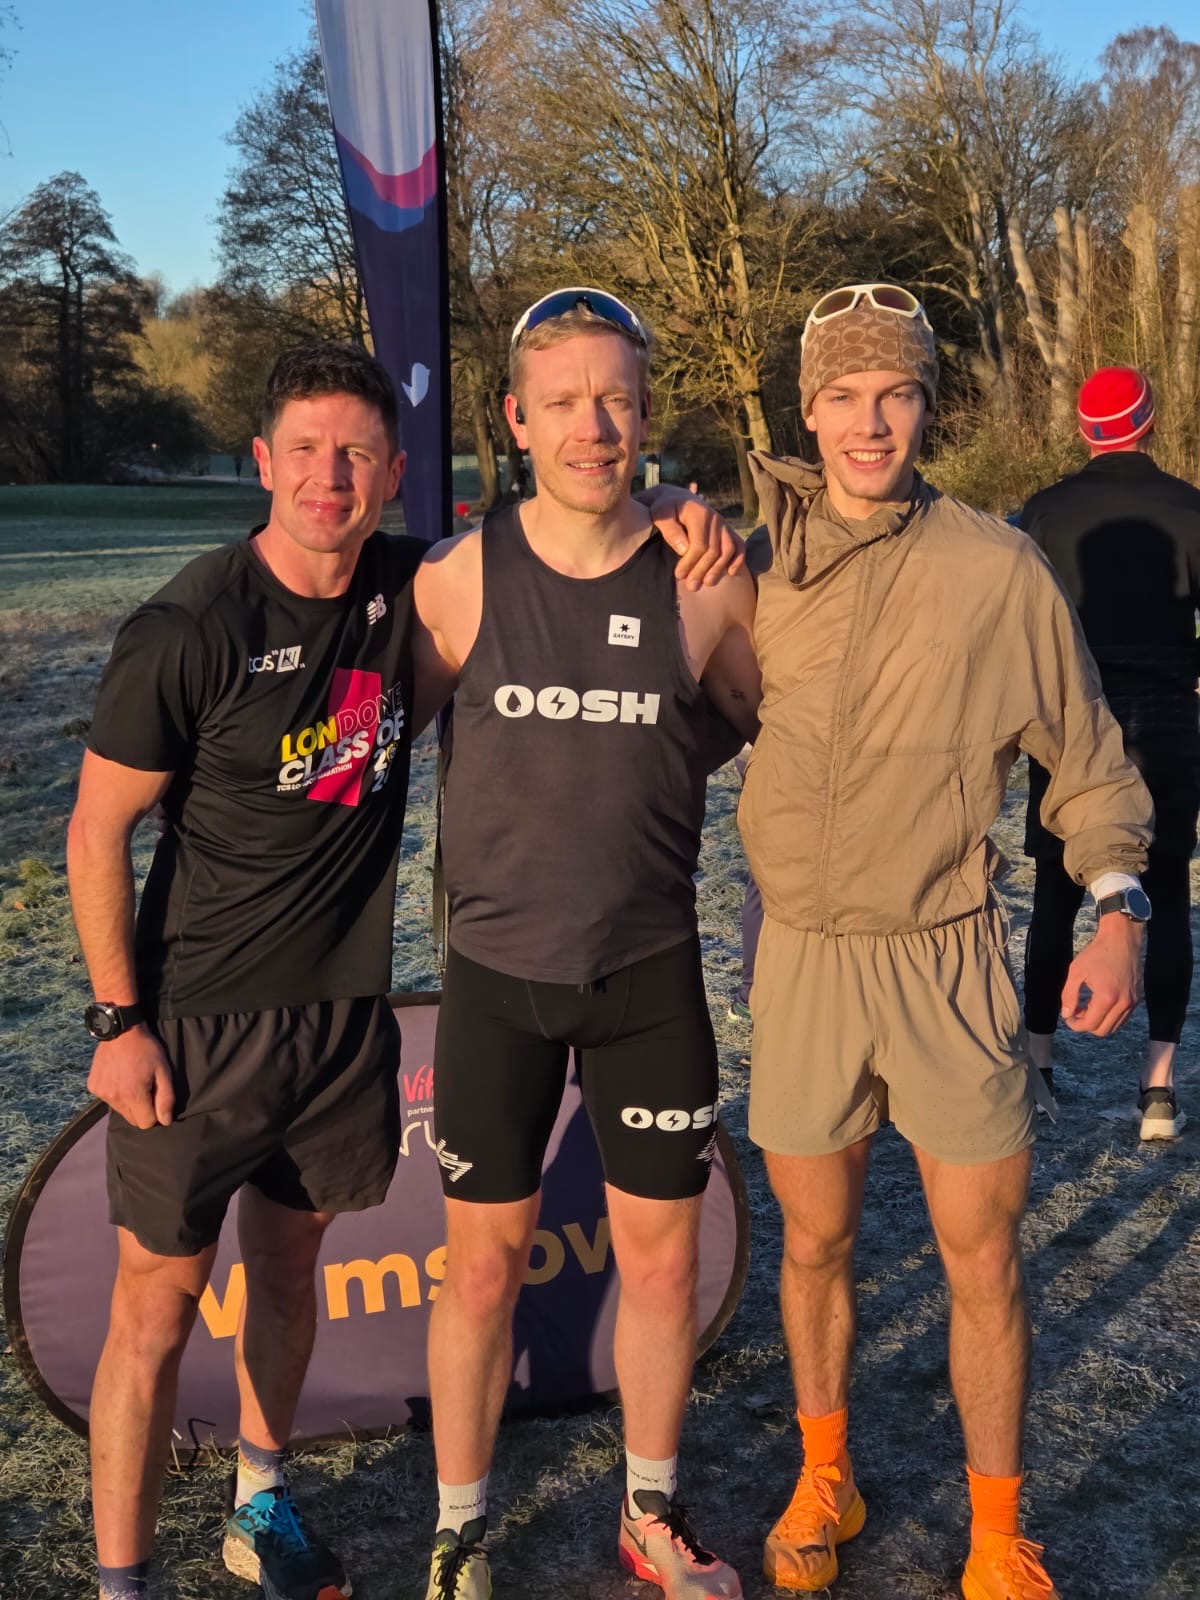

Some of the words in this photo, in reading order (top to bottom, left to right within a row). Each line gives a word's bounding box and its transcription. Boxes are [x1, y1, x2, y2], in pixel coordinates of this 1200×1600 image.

[494, 684, 661, 725] OOSH
[279, 730, 370, 784] CLASS
[376, 708, 405, 747] OF
